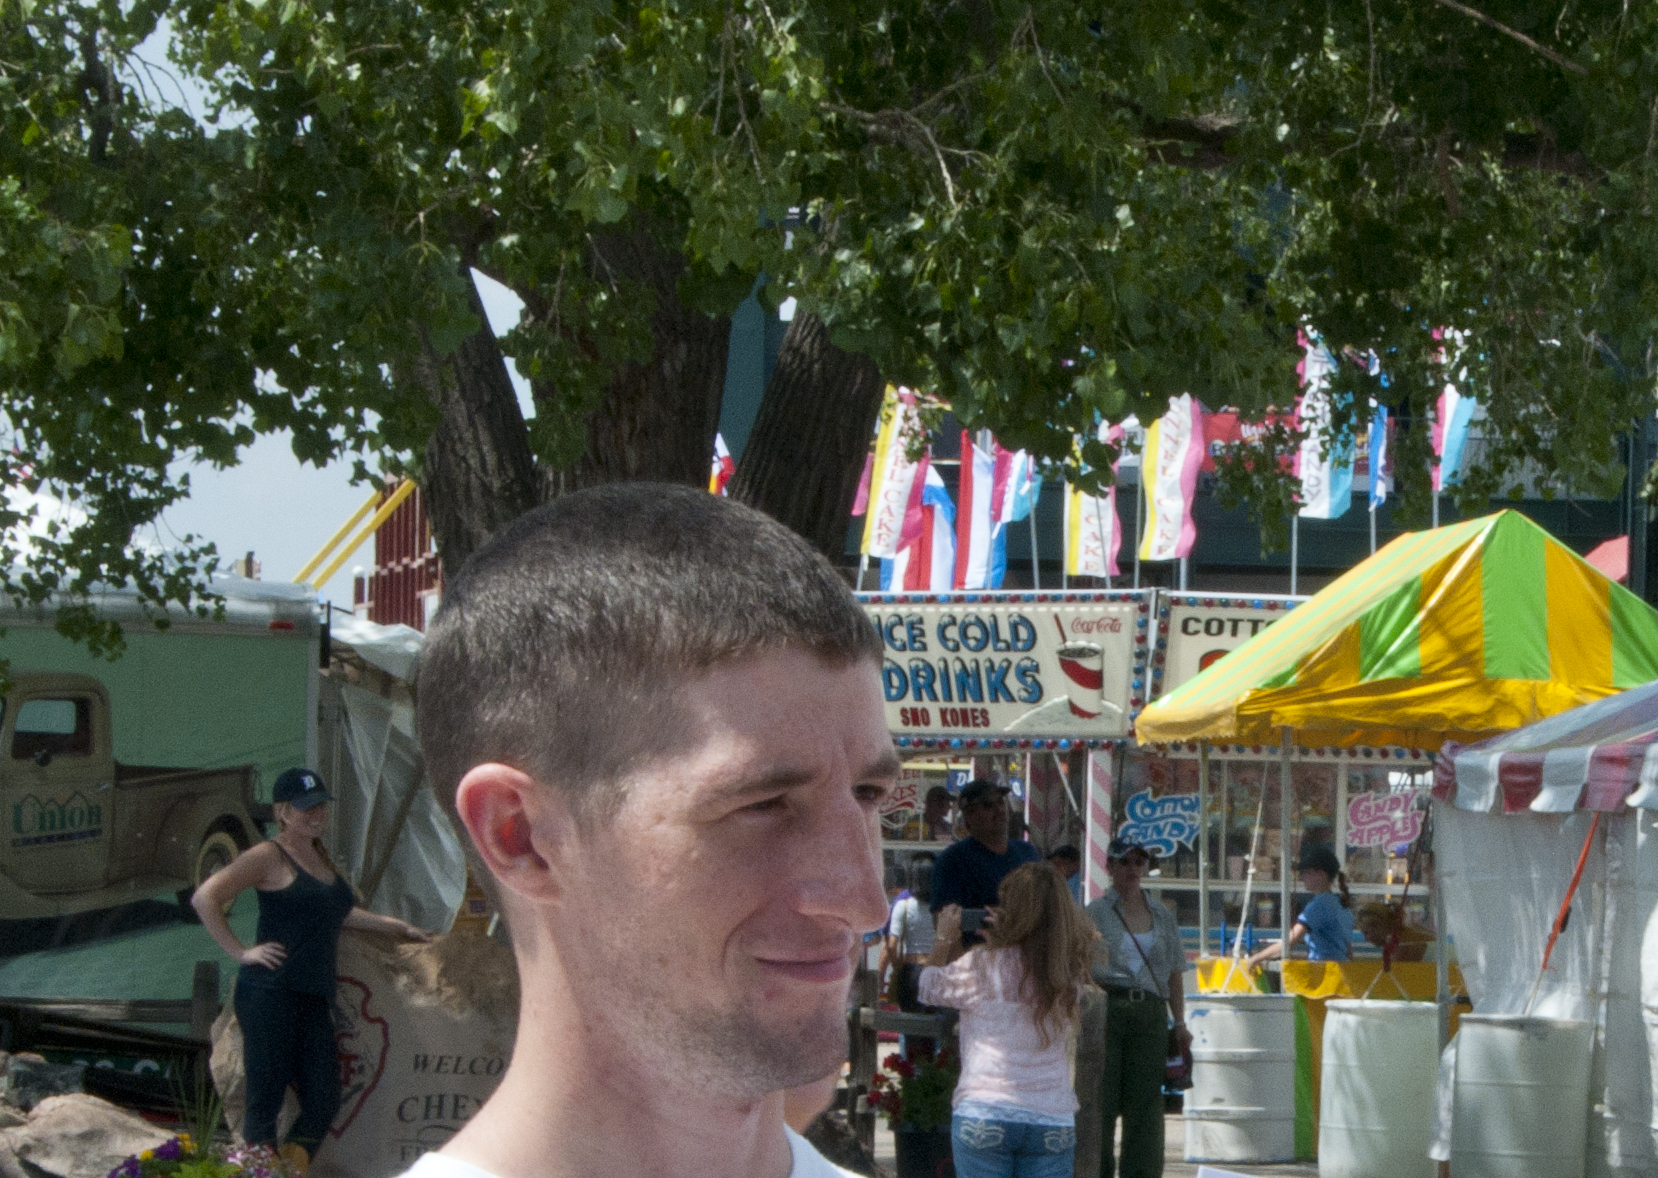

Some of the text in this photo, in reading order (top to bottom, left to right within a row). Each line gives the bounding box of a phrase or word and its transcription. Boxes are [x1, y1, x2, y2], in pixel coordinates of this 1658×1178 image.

[876, 489, 901, 549] CAKE
[937, 613, 1037, 652] COLD
[1181, 617, 1278, 637] COTT
[882, 656, 1044, 703] DRINKS
[901, 707, 990, 728] SNO KONES
[1348, 786, 1421, 827] CANDY
